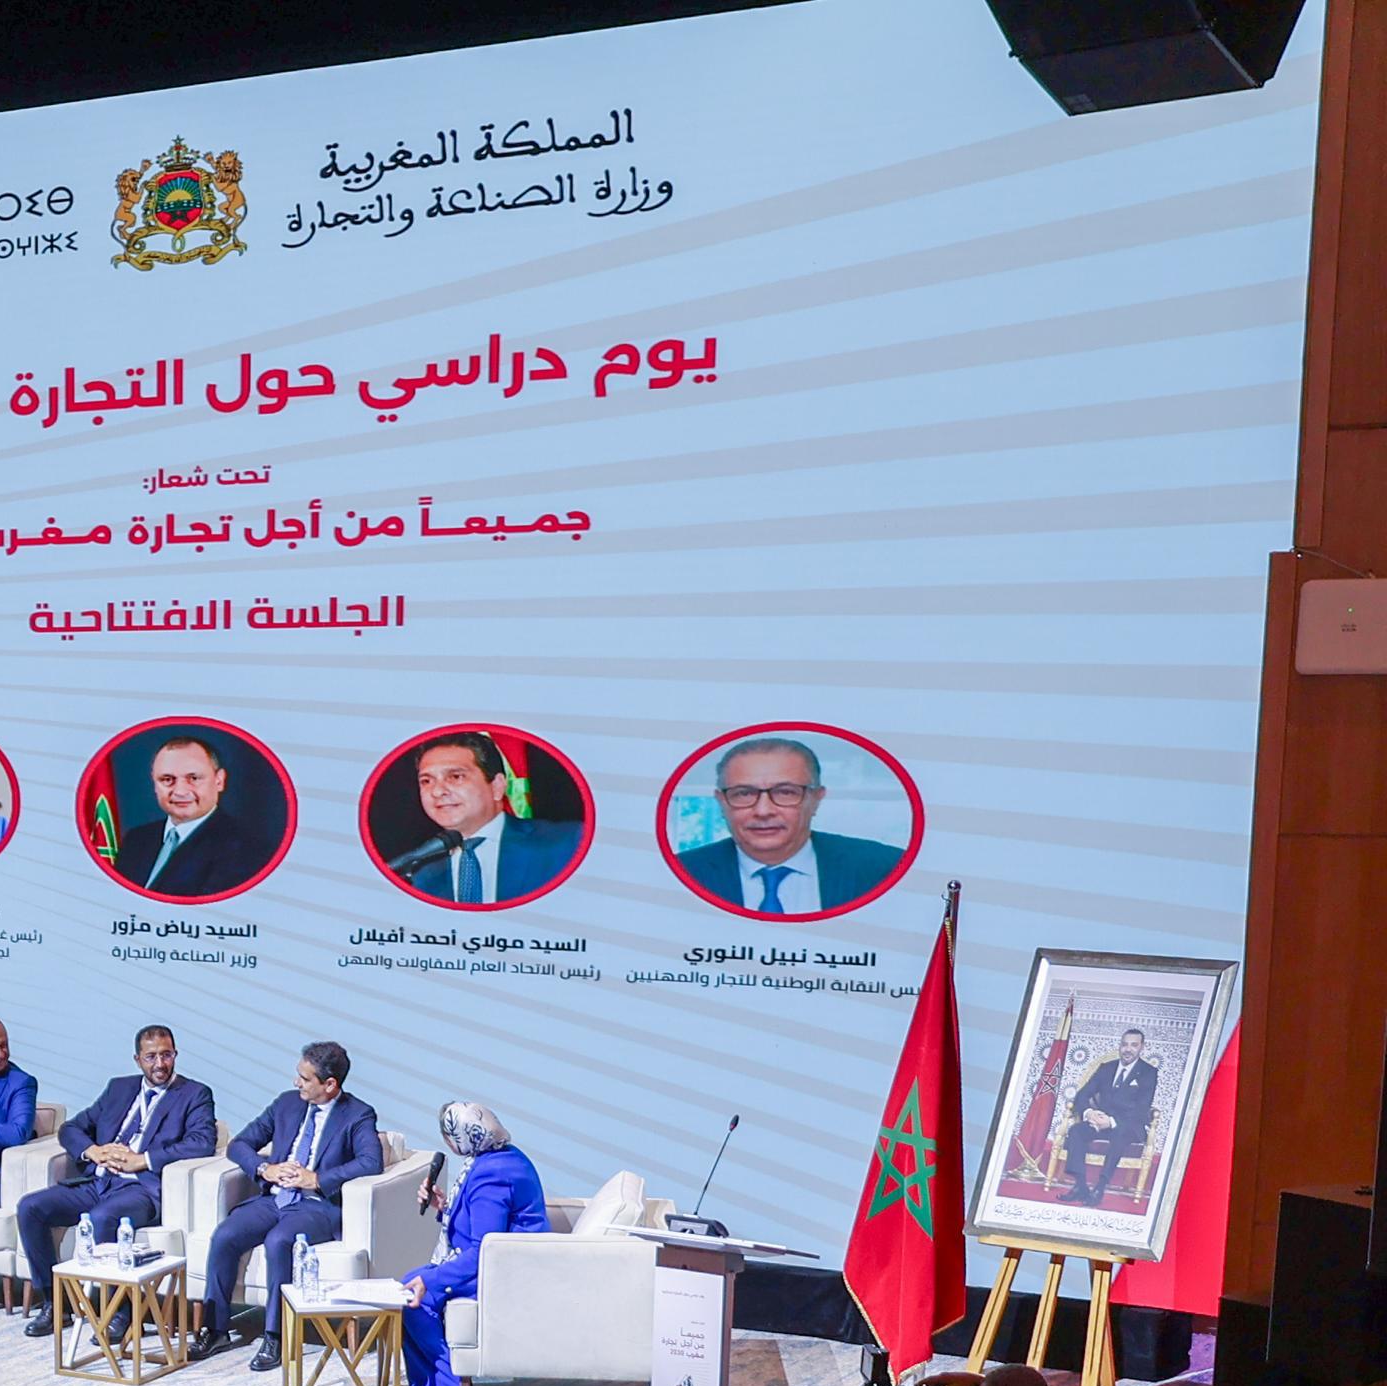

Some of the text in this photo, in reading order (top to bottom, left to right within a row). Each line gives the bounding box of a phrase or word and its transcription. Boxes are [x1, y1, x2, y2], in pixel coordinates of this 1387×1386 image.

[320, 108, 634, 195] المملكة المغربية
[282, 167, 673, 248] وزارة الصناعة والتجارة
[359, 334, 567, 423] دراسي
[593, 336, 718, 398] يوم
[10, 359, 183, 428] التجارة
[206, 353, 336, 414] حول
[144, 466, 271, 494] تحت شعار:
[128, 514, 233, 553] تجارة
[244, 499, 322, 549] أجل
[334, 511, 404, 546] من
[29, 597, 407, 640] الجلسة الافتتاحية
[10, 930, 42, 944] رئيس
[156, 920, 199, 939] رياض
[205, 924, 256, 939] السيد
[350, 927, 586, 954] السيد مولاي أحمد أفيلال
[112, 946, 257, 968] وزير الصناعة والتجارة
[338, 955, 600, 981] رئيس الاتحاد العام للمقاولات والمهن
[684, 946, 876, 968] السيد نبيل النوري
[626, 971, 709, 987] والمهنيين
[714, 973, 757, 988] للتجار
[762, 976, 825, 993] الوطنية
[831, 980, 885, 993] النقابة
